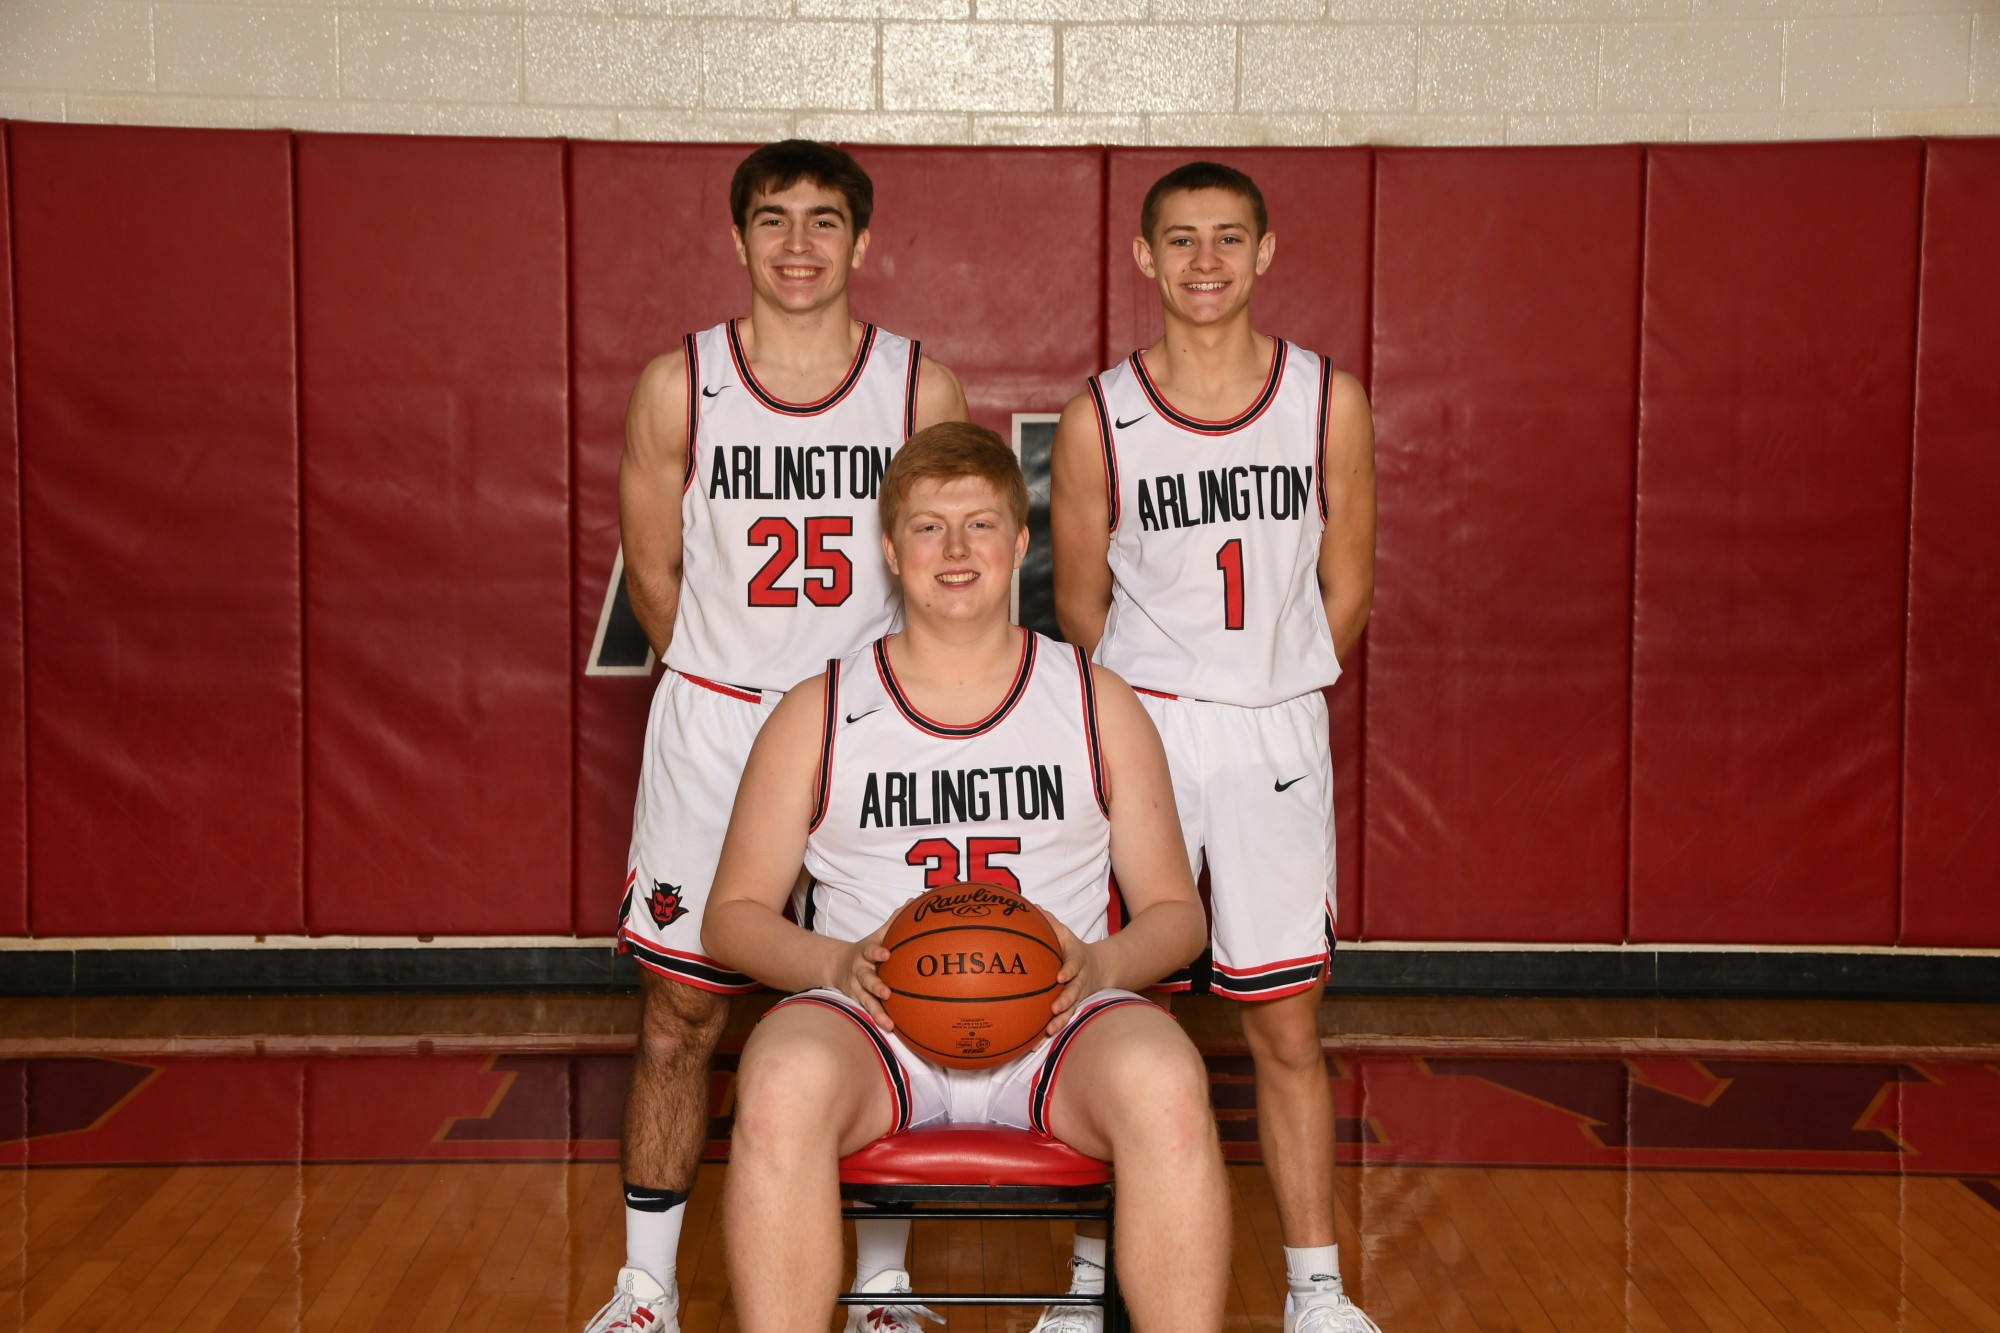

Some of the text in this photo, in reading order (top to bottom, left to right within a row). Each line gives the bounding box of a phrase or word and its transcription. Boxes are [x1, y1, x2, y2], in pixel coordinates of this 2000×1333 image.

[709, 445, 892, 500] ARLINGTON
[1138, 464, 1313, 531] ARLINGTON
[747, 516, 853, 607] 25
[1216, 538, 1245, 630] 1
[859, 764, 1065, 829] ARLINGTON
[914, 888, 1030, 922] Rawlings
[916, 952, 1028, 977] OHSAA
